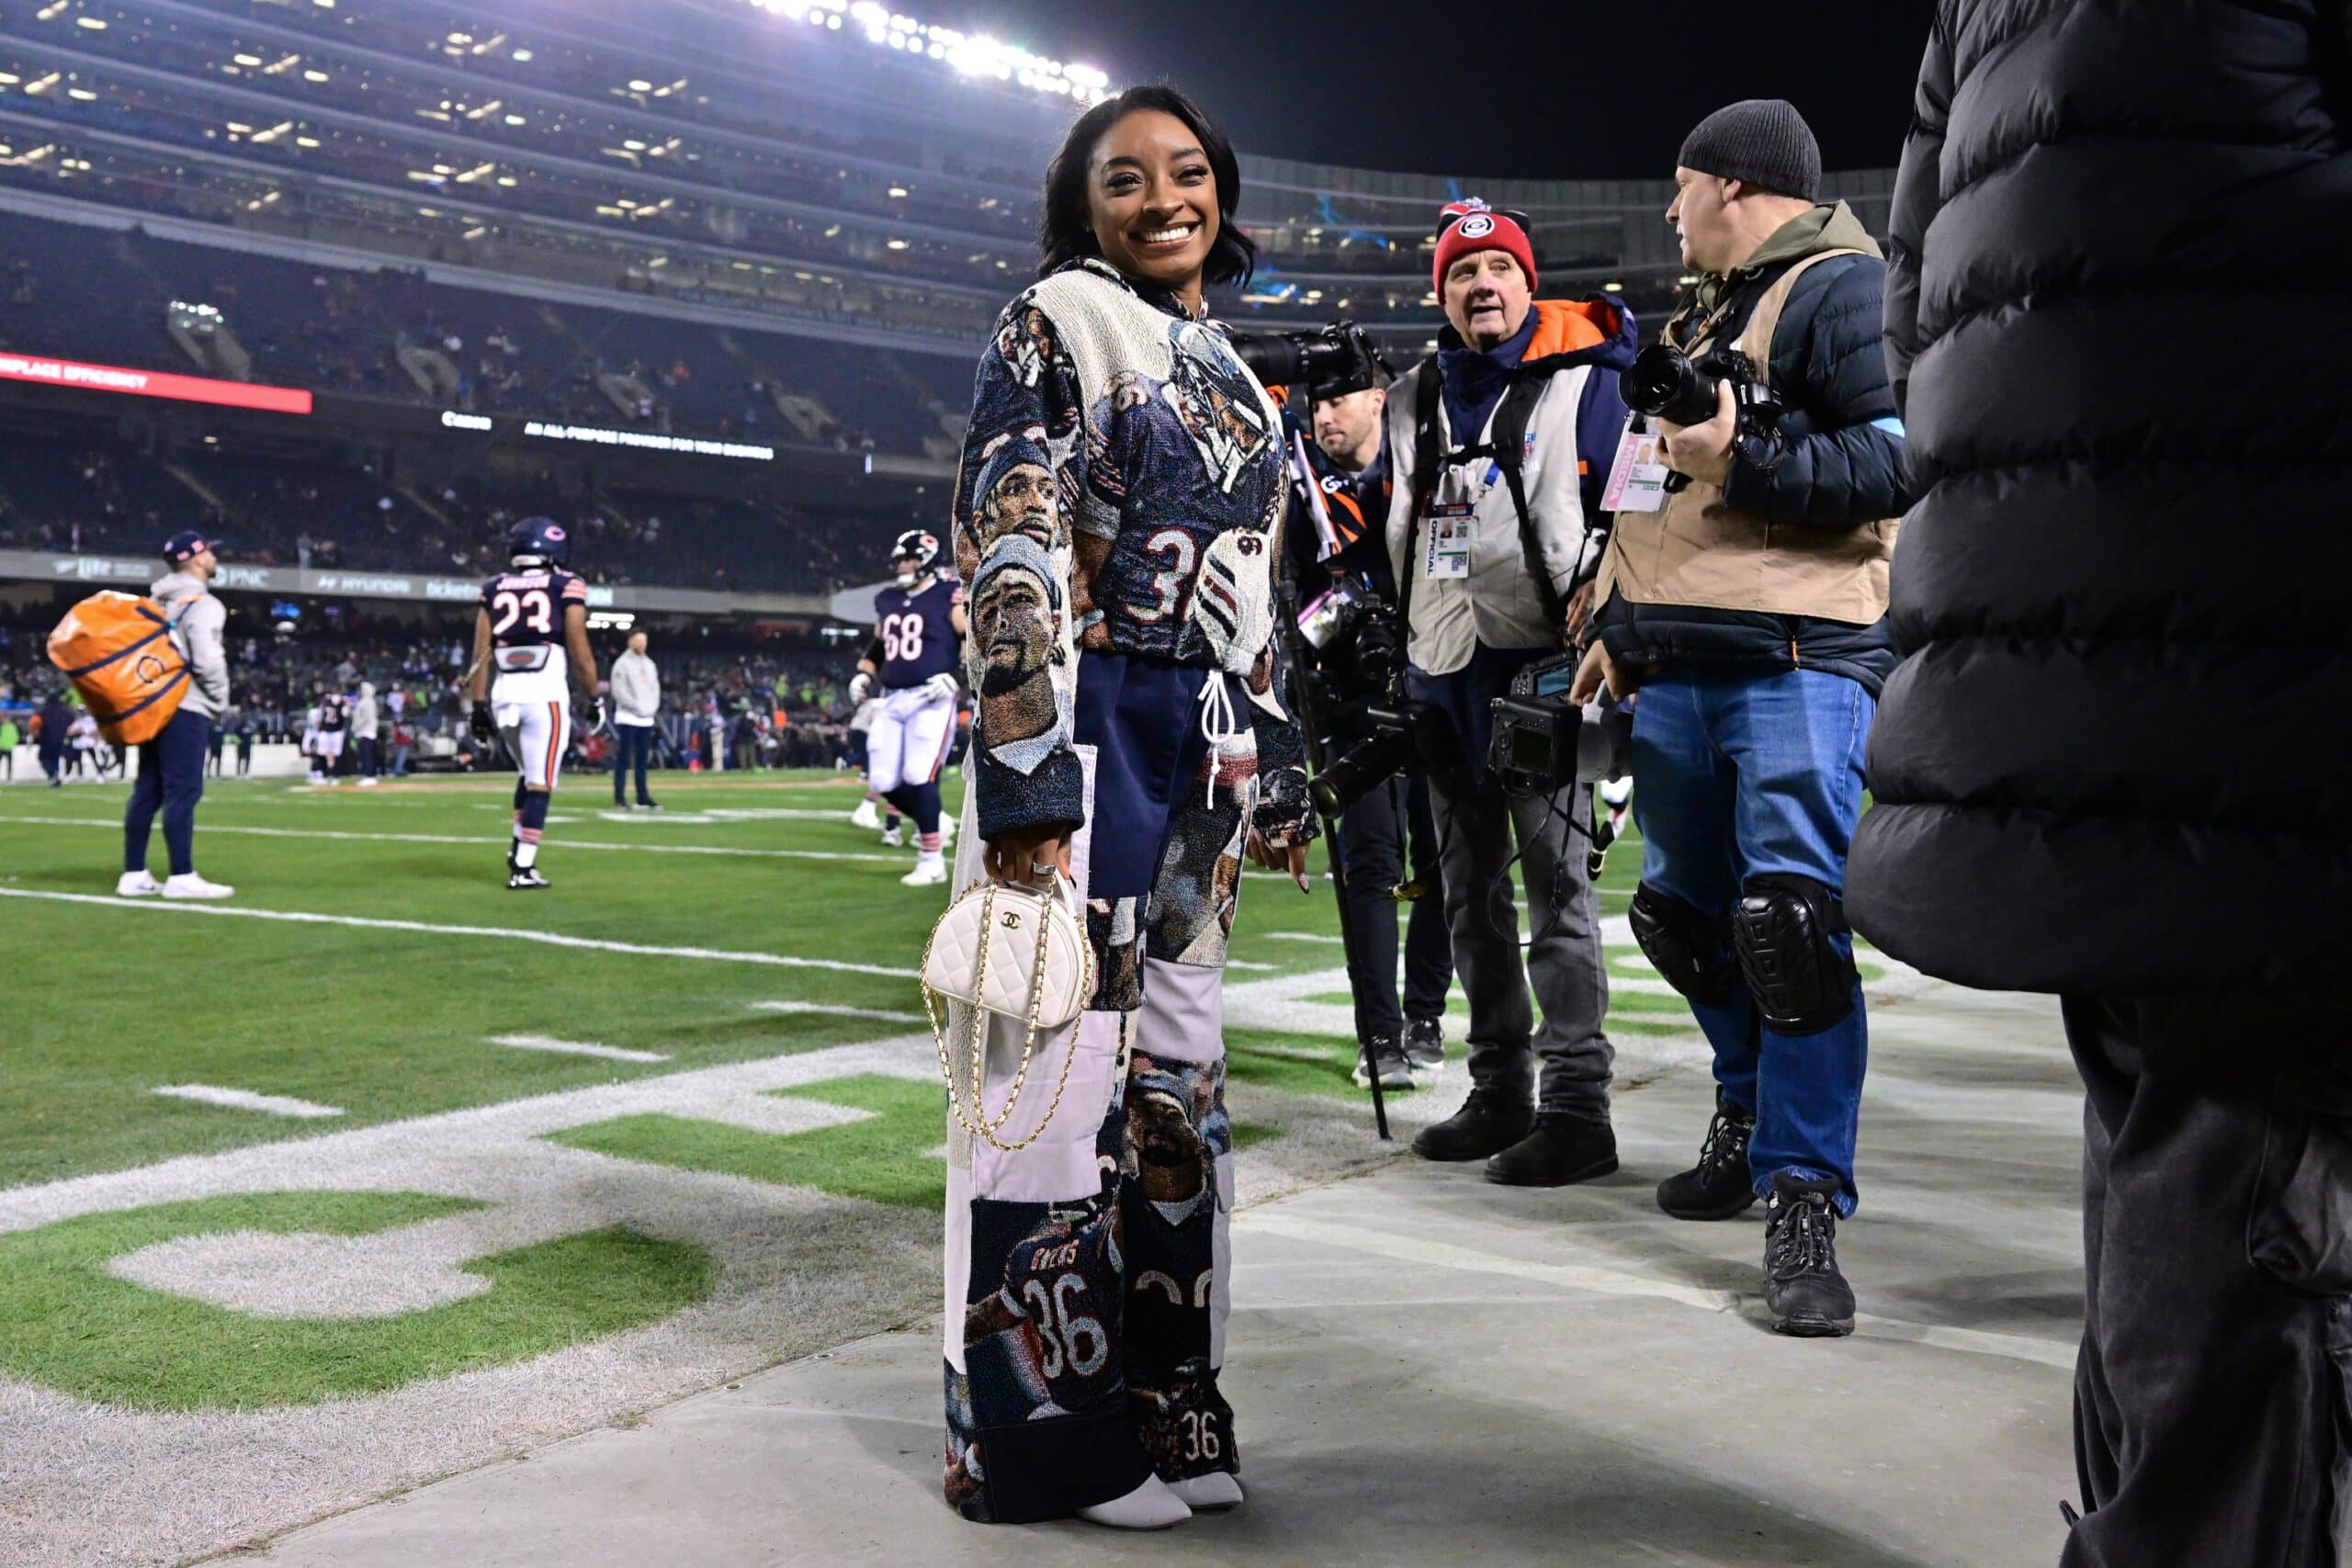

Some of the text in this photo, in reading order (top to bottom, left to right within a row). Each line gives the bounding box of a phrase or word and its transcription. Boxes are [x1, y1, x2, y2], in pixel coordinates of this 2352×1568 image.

[1610, 444, 1635, 500] MEDIA
[1428, 521, 1438, 576] OFFICIAL
[230, 569, 270, 587] PNC
[341, 577, 412, 592] HYUNDAI
[492, 590, 551, 635] 23
[882, 613, 924, 661] 68
[1023, 1273, 1108, 1378] 36
[1182, 1410, 1220, 1461] 36
